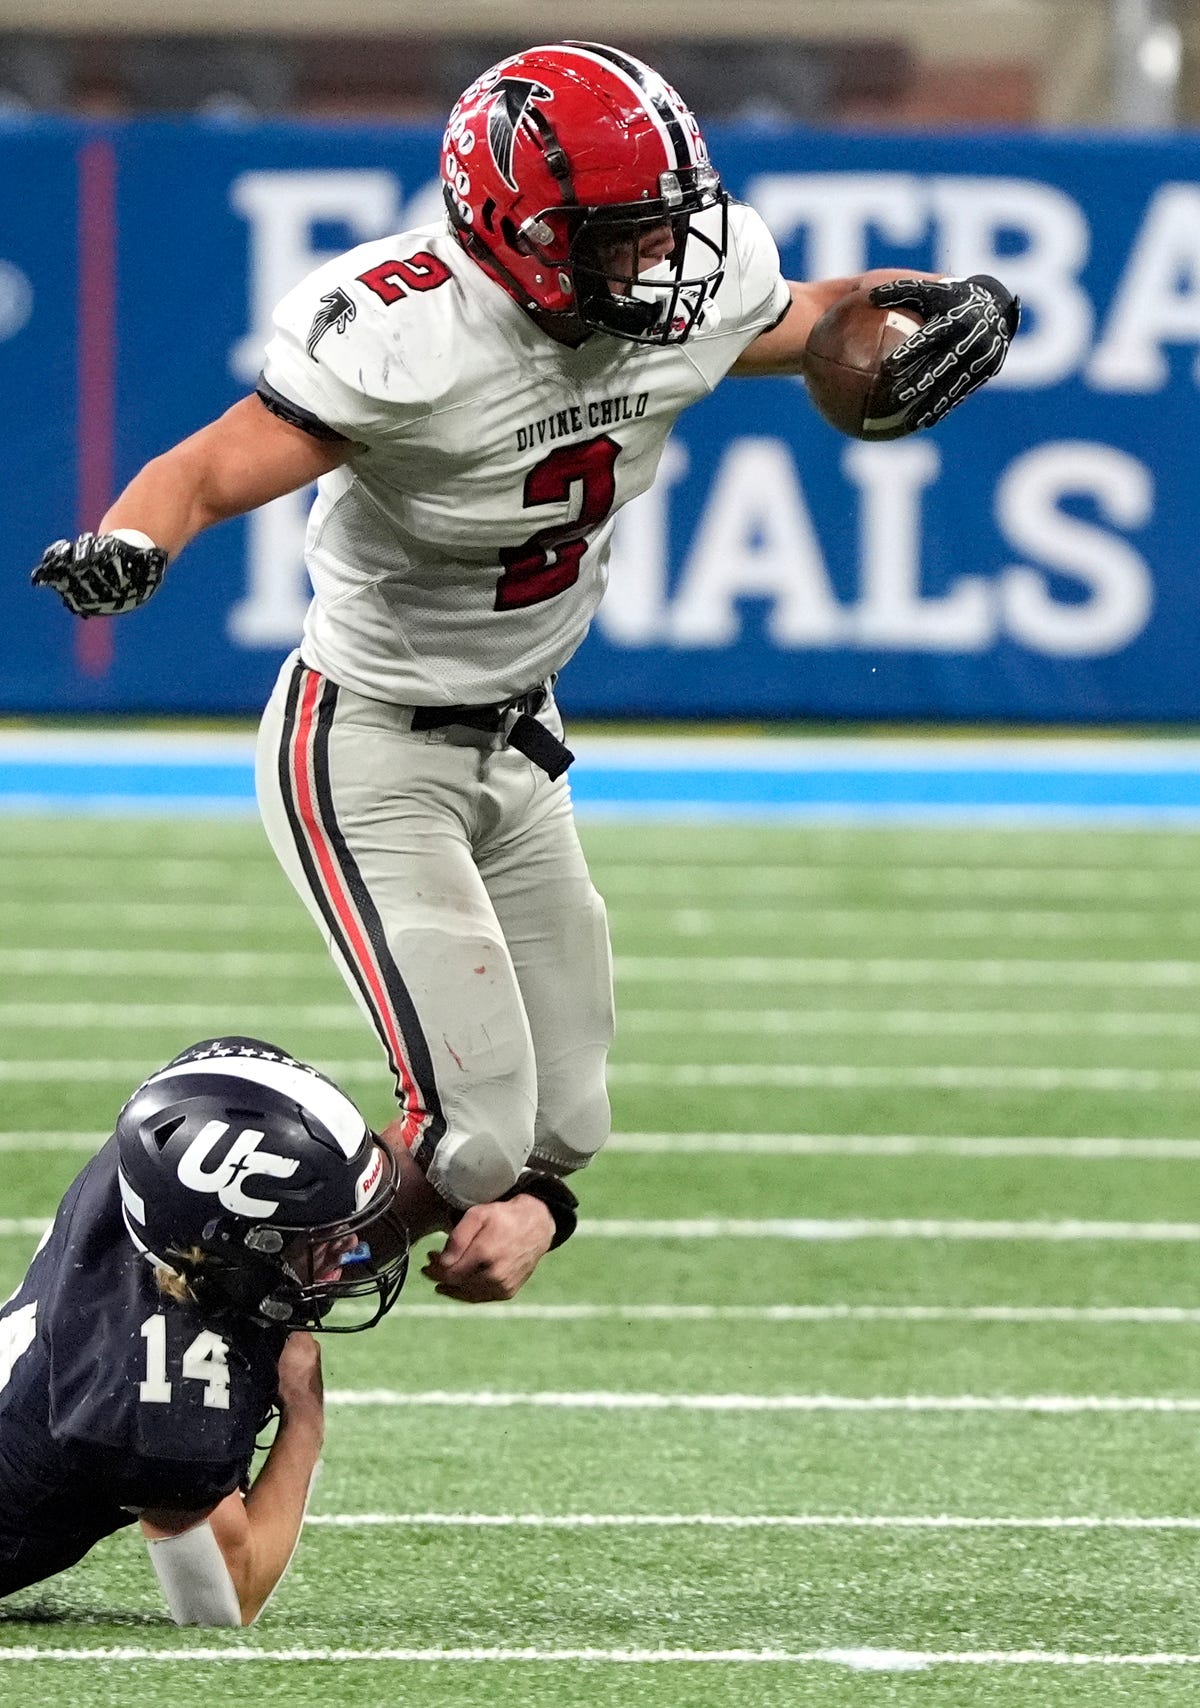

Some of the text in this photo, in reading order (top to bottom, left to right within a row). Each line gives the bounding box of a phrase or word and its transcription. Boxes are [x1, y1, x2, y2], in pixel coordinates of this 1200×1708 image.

[230, 168, 1200, 396] FTBA
[355, 251, 453, 306] 2
[515, 392, 650, 452] DIVINE CHILD
[493, 433, 624, 612] 2
[176, 1119, 301, 1219] UC
[139, 1313, 231, 1410] 14
